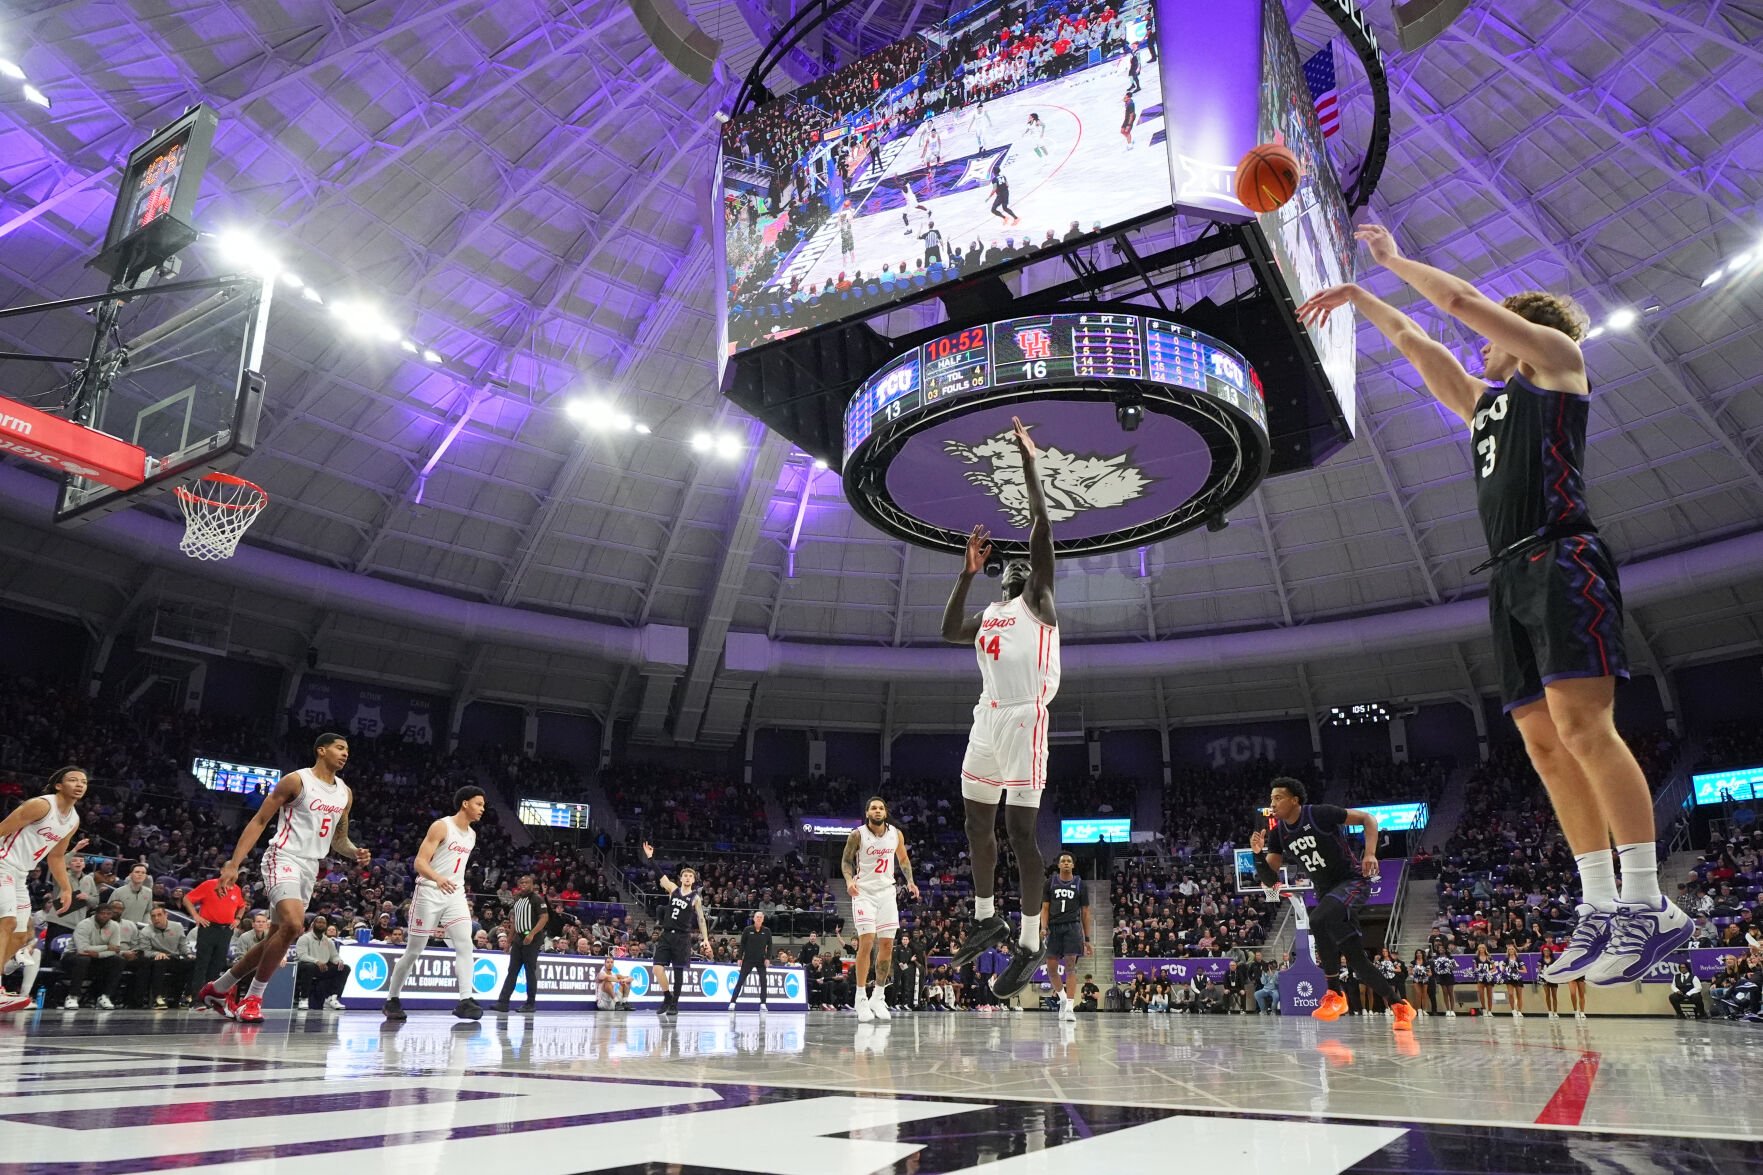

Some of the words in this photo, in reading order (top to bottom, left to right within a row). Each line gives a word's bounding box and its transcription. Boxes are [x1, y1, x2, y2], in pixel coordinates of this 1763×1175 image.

[1170, 325, 1182, 333] PT
[928, 328, 984, 360] 10:52
[1019, 329, 1051, 359] UH
[1106, 347, 1112, 355] 2
[938, 355, 962, 369] HALF
[965, 351, 970, 361] 1
[1081, 357, 1093, 365] 14
[1107, 357, 1113, 365] 2
[947, 371, 963, 382] TOL
[974, 366, 980, 374] 4
[1022, 361, 1047, 379] 16
[1081, 367, 1094, 375] 21
[1107, 367, 1114, 376] 2
[1129, 368, 1136, 376] 0
[1210, 353, 1244, 388] TCU
[876, 369, 912, 406] TCU
[928, 389, 938, 399] 03
[942, 380, 970, 395] FOULS
[972, 377, 983, 386] 05
[1223, 385, 1239, 408] 13
[885, 401, 900, 420] 13
[1477, 434, 1496, 478] 3
[982, 616, 1016, 631] ugars
[979, 635, 1000, 661] 14
[358, 717, 378, 732] 52
[1205, 735, 1277, 768] TCU
[318, 818, 331, 837] 5
[33, 845, 48, 861] 4
[1288, 835, 1317, 856] TCU
[453, 857, 461, 874] 1
[874, 858, 889, 874] 21
[1301, 850, 1327, 872] 24
[1054, 888, 1075, 899] TCU
[671, 897, 688, 909] TCU
[1060, 899, 1066, 913] 1
[671, 907, 680, 920] 2
[539, 964, 596, 981] TAYLOR'S
[1040, 964, 1065, 975] TU
[1650, 961, 1681, 977] TCU
[418, 976, 457, 987] EQUIPMENT
[537, 980, 558, 989] RENTAL
[559, 981, 589, 990] EQUIPMENT
[1293, 996, 1319, 1007] Frost
